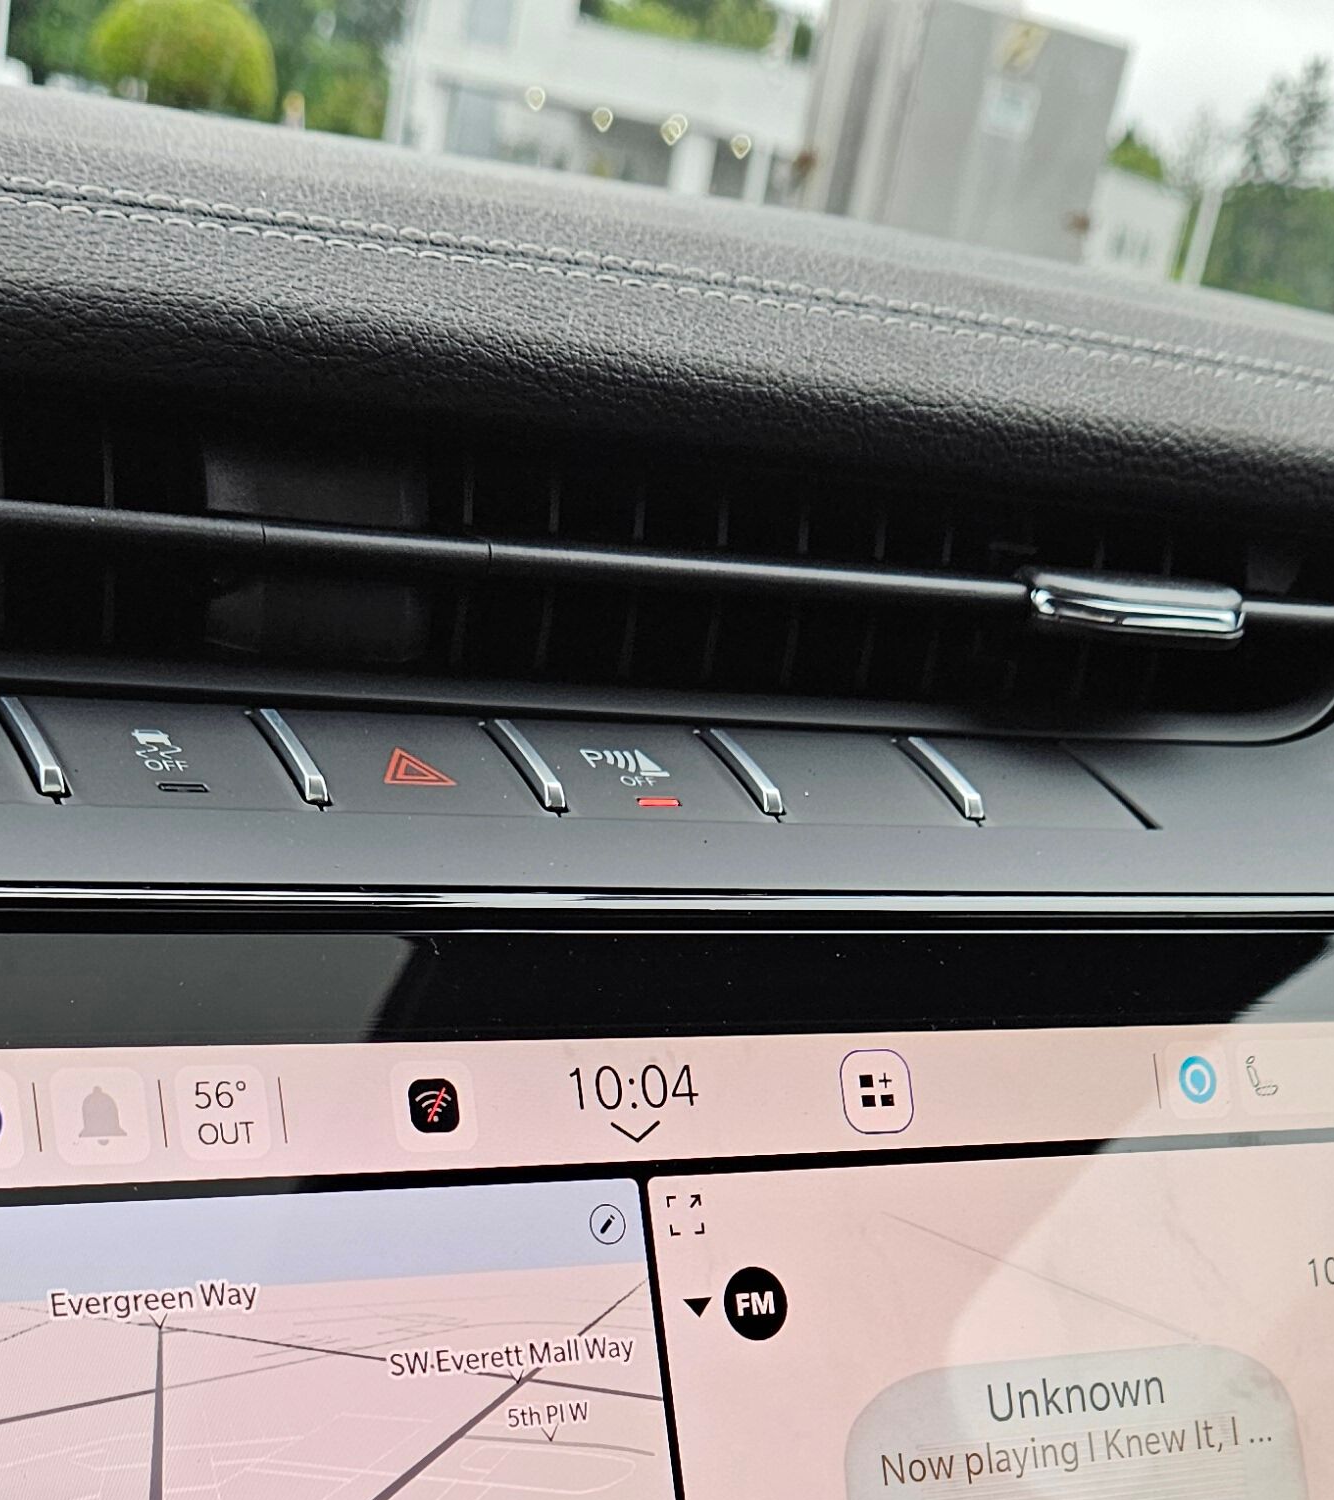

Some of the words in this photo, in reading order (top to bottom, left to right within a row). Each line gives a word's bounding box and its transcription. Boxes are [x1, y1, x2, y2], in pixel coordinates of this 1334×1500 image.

[144, 758, 189, 772] OFF
[620, 776, 656, 787] OFF
[194, 1080, 247, 1110] 56°
[569, 1064, 699, 1110] 10:04
[199, 1120, 254, 1145] OUT
[51, 1288, 194, 1322] Evergreen
[198, 1282, 257, 1313] Way
[736, 1291, 776, 1317] FM
[390, 1353, 432, 1376] SW
[436, 1345, 522, 1373] Everett
[530, 1340, 578, 1364] Mall
[584, 1336, 633, 1365] Way
[507, 1406, 541, 1427] 5th
[546, 1402, 566, 1425] Pl
[567, 1402, 588, 1422] W
[988, 1377, 1165, 1422] Unknown
[881, 1450, 955, 1487] Now
[966, 1437, 1079, 1484] playing
[1106, 1424, 1187, 1461] Knew
[1195, 1419, 1223, 1453] It,
